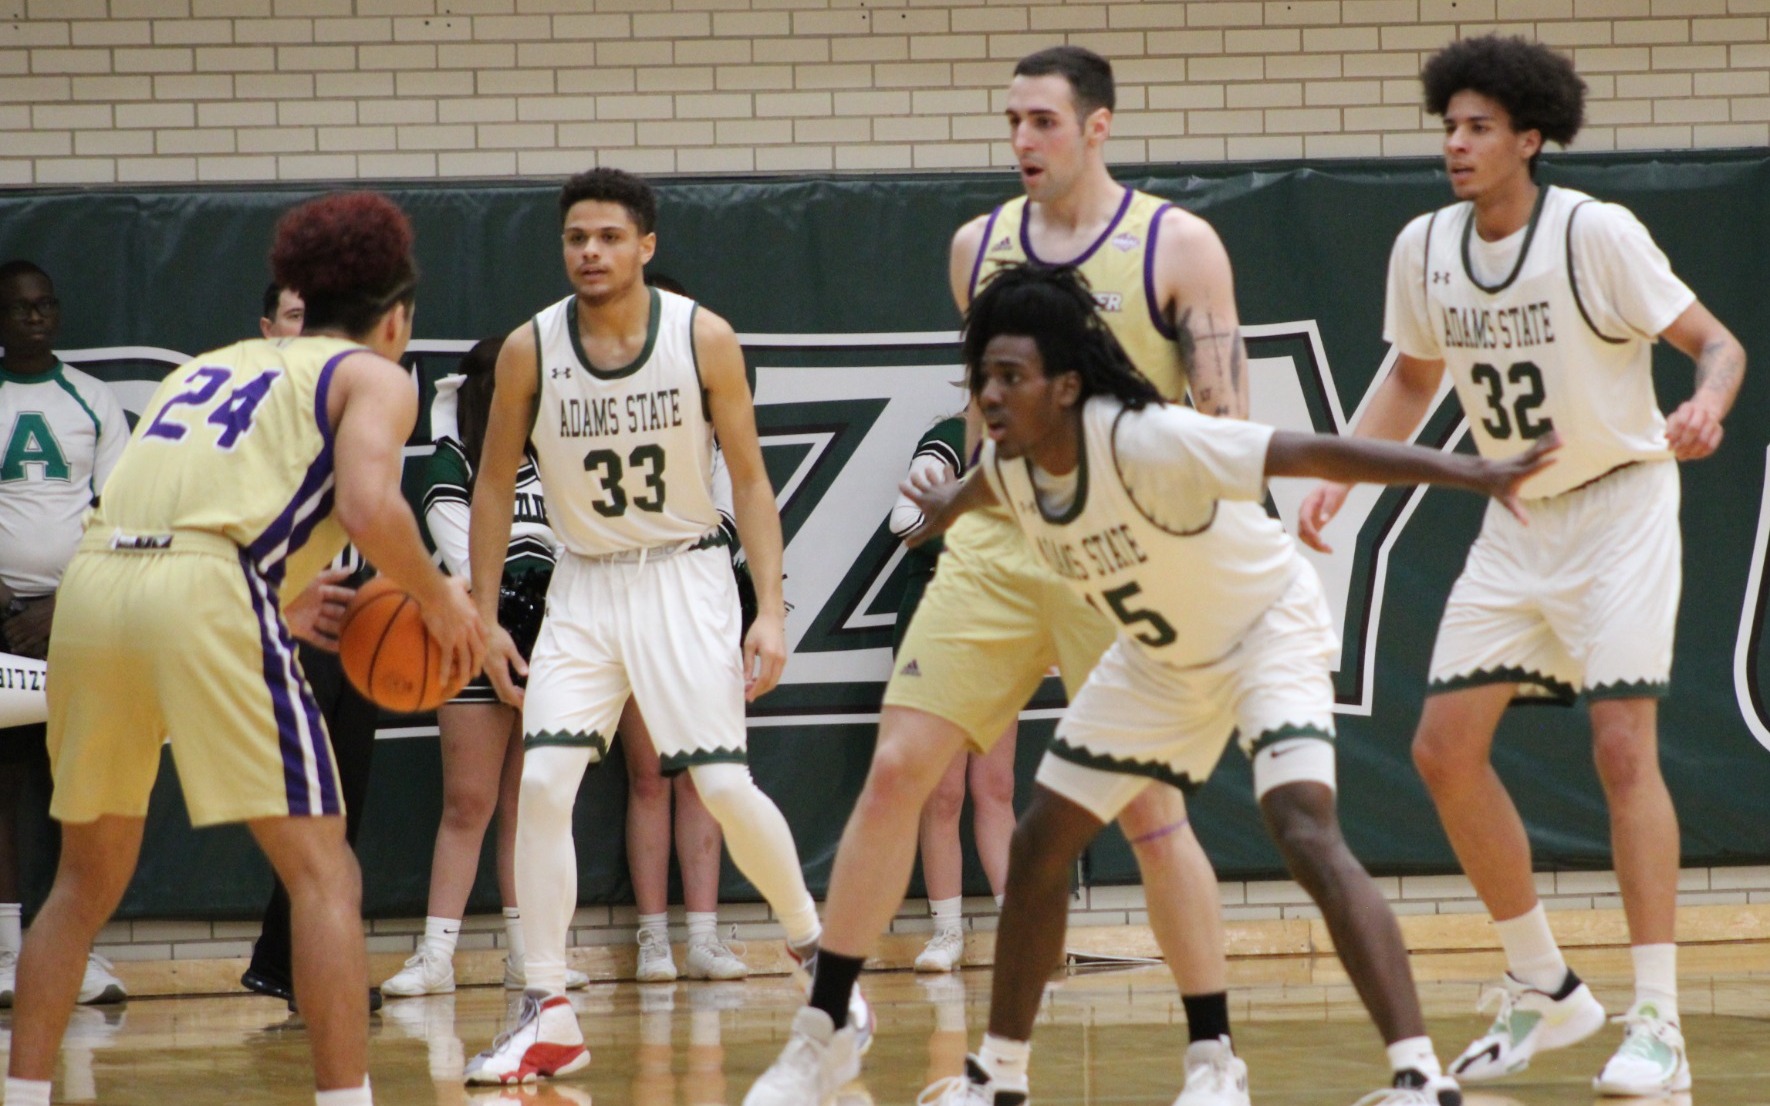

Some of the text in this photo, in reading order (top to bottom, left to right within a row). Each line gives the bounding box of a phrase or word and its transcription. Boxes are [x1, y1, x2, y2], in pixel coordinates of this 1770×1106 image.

[1442, 301, 1555, 349] ADAMS STATE
[141, 366, 283, 452] 24
[560, 388, 682, 437] ADAMS STATE
[1470, 361, 1555, 440] 32
[0, 411, 72, 482] A
[583, 443, 666, 518] 33
[1081, 524, 1148, 576] STATE
[1085, 580, 1178, 648] 5
